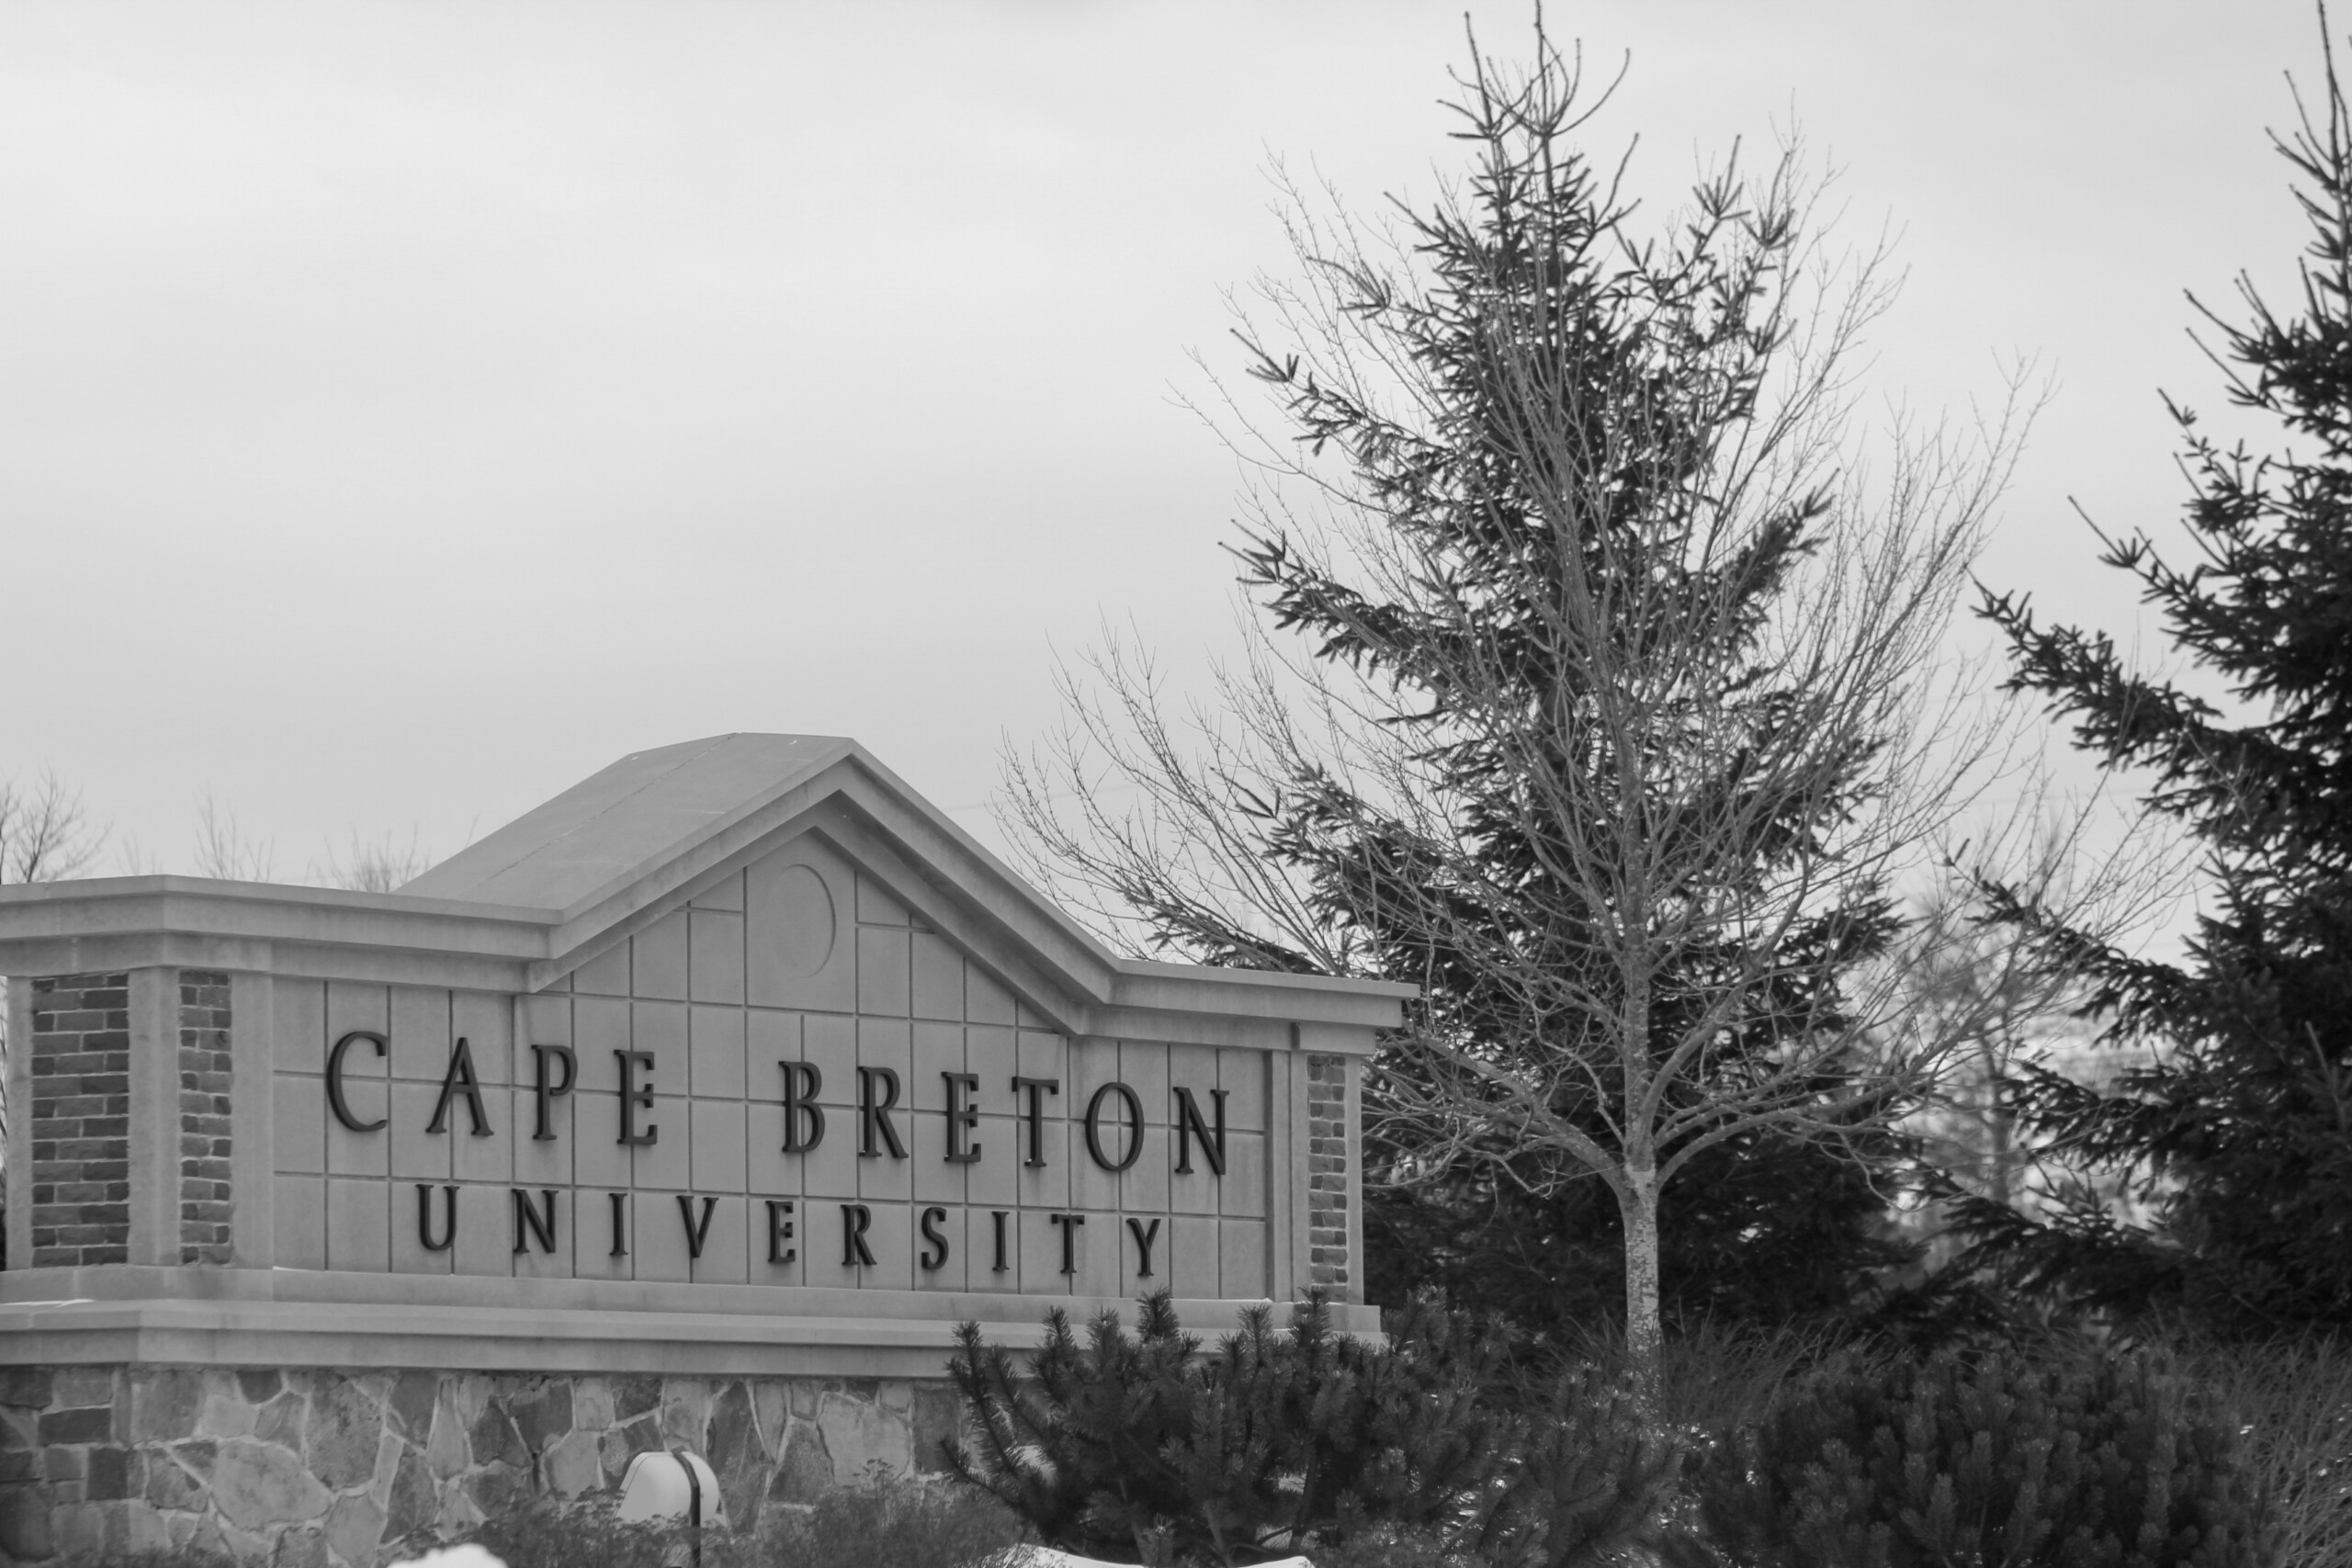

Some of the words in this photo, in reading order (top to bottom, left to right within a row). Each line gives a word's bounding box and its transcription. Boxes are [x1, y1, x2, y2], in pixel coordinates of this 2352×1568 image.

[326, 1031, 659, 1145] CAPE
[778, 1060, 1230, 1176] BRETON
[415, 1183, 1161, 1278] UNIVERSITY
